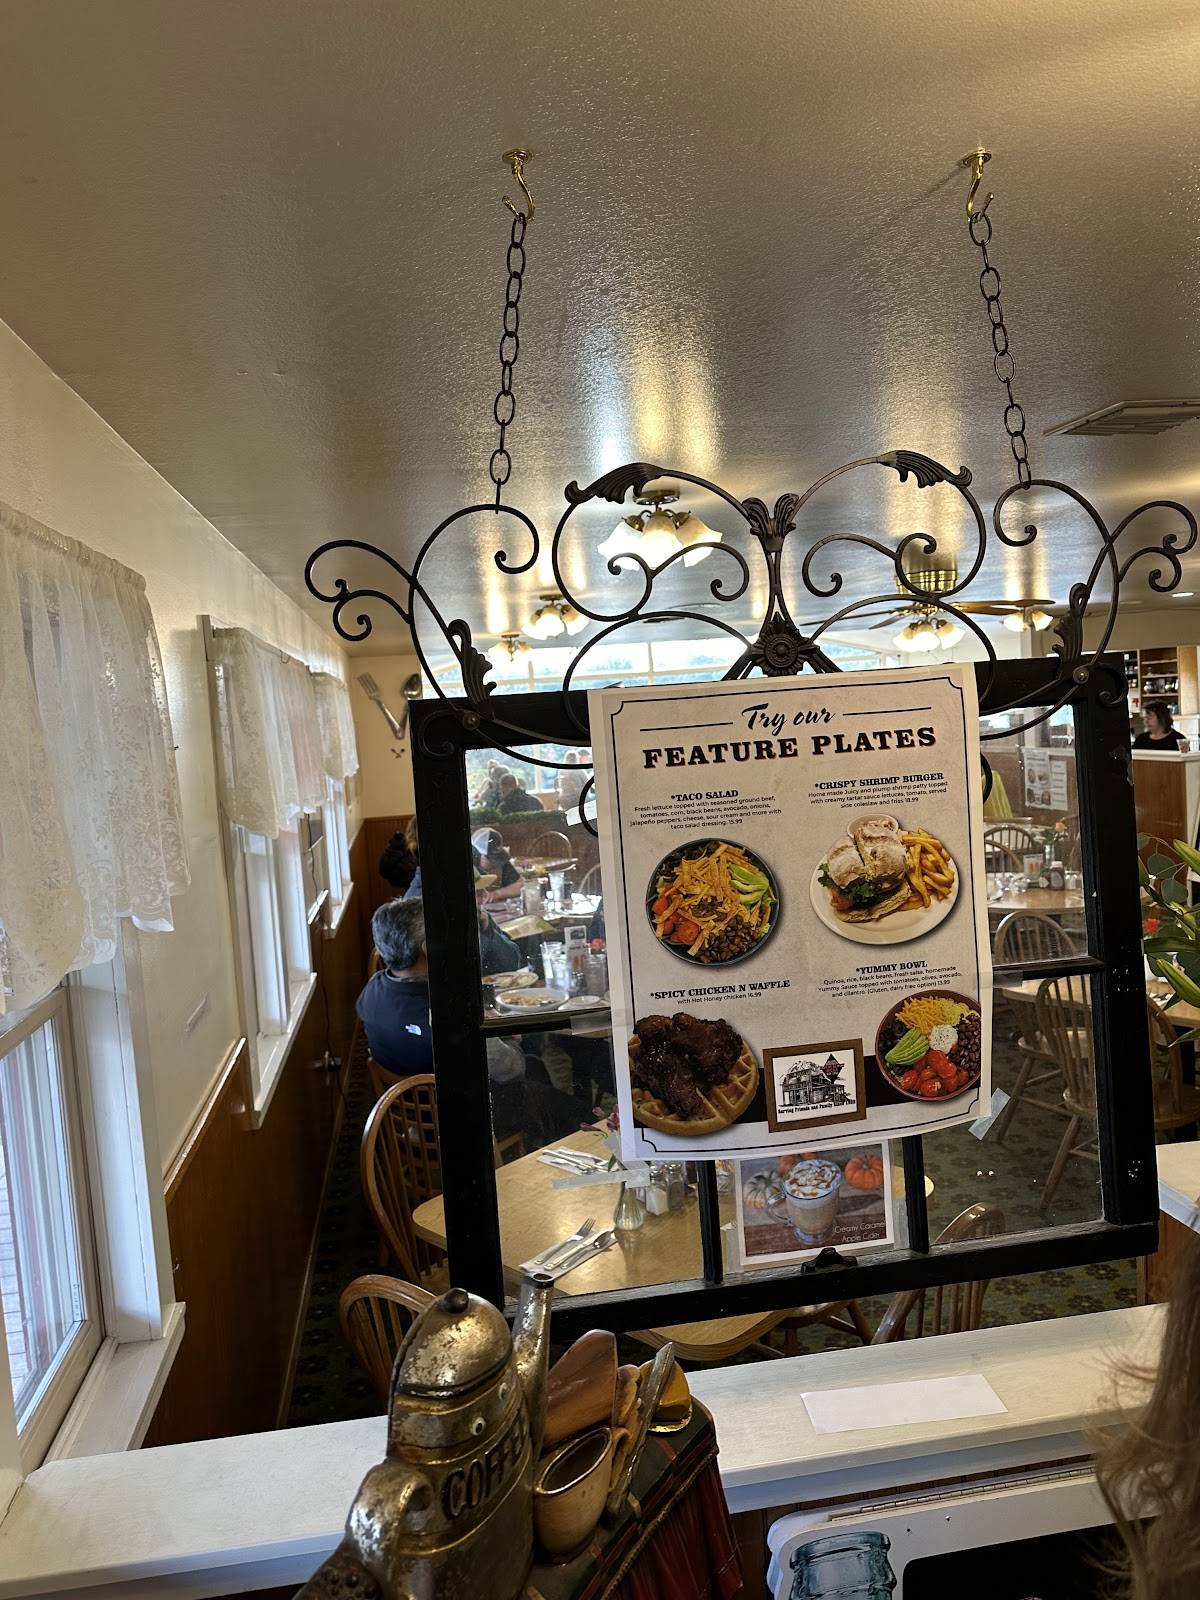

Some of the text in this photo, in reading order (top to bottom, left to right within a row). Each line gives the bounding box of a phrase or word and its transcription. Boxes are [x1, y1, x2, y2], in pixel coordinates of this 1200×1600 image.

[741, 703, 836, 736] Try our
[642, 726, 936, 769] FEATURE PLATES
[860, 776, 900, 786] SHRIMP
[903, 772, 944, 782] BURGER
[706, 789, 739, 799] SALAD
[900, 960, 928, 970] BOWL
[688, 985, 736, 997] CHICKEN
[748, 980, 790, 990] WAFFLE
